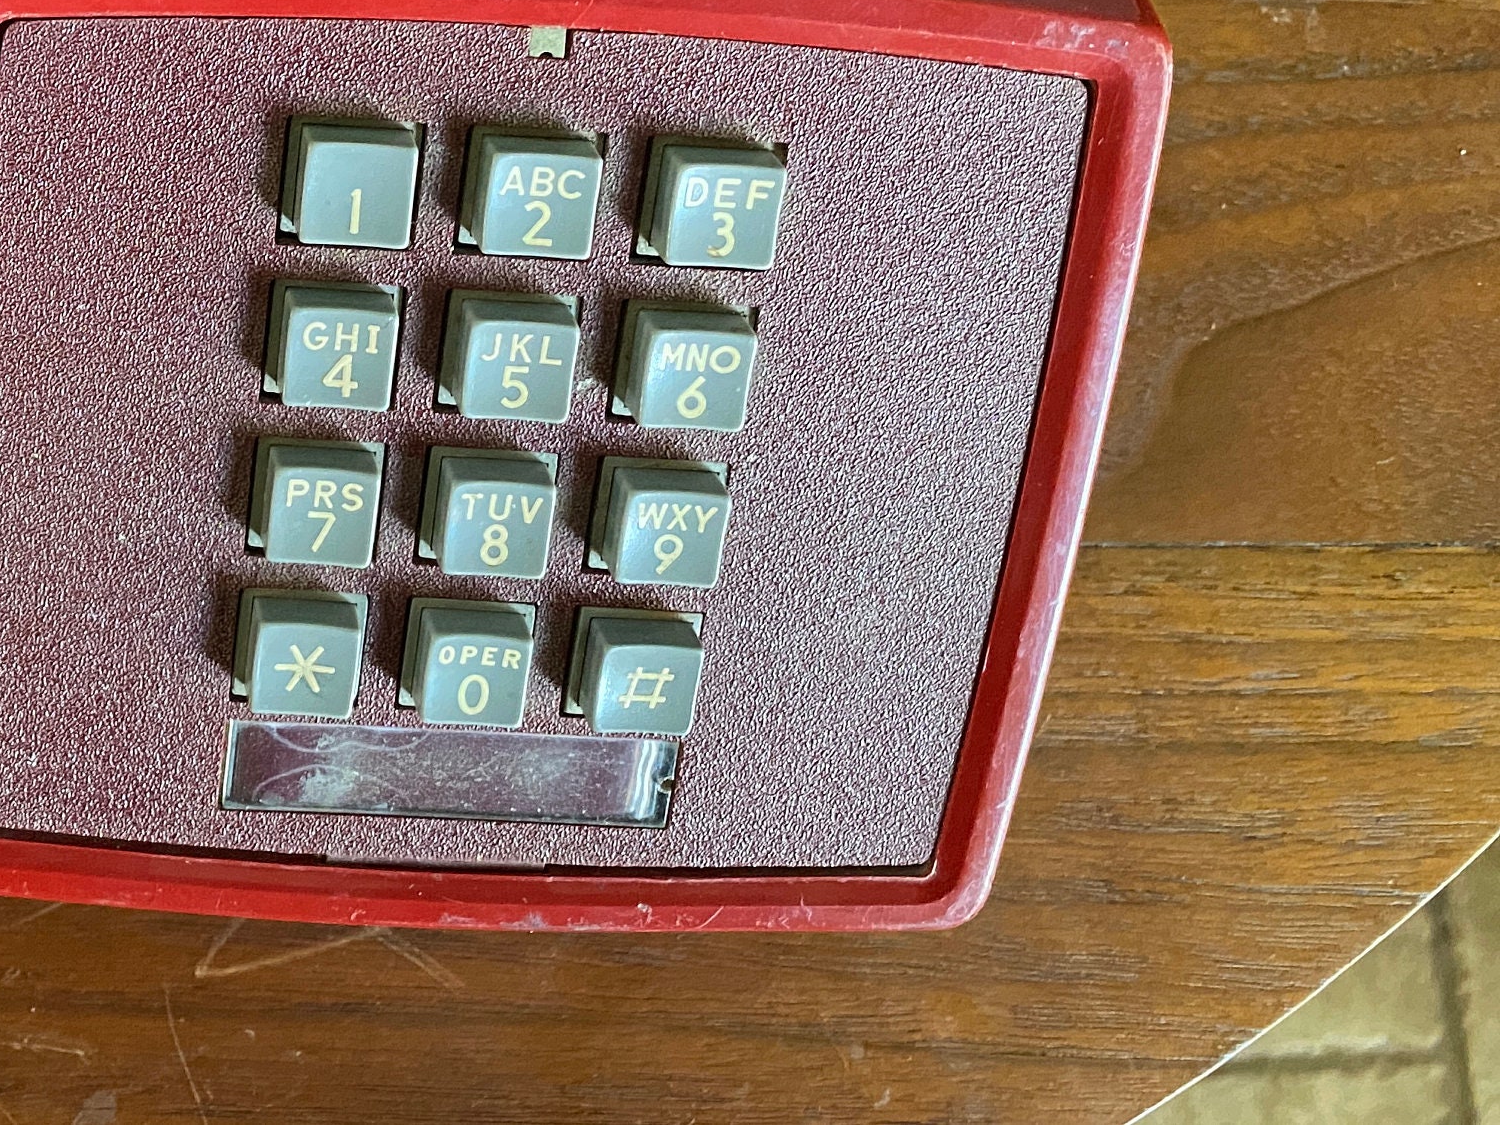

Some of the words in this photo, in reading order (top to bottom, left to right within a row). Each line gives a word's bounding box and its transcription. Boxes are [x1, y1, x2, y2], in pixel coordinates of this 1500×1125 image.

[499, 166, 584, 200] ABC
[684, 177, 776, 210] DEF
[349, 188, 362, 235] 1
[522, 201, 553, 247] 2
[707, 211, 736, 258] 3
[302, 322, 381, 354] GHI
[481, 333, 562, 366] JKL
[658, 343, 741, 374] MNO
[322, 354, 359, 398] 4
[501, 366, 529, 409] 5
[676, 376, 707, 419] 6
[286, 479, 364, 512] PRS
[461, 493, 544, 525] TUV
[306, 512, 337, 553] 7
[637, 502, 718, 534] WXY
[479, 524, 509, 567] 8
[654, 534, 683, 575] 9
[438, 645, 522, 670] OPER
[457, 674, 490, 716] 0
